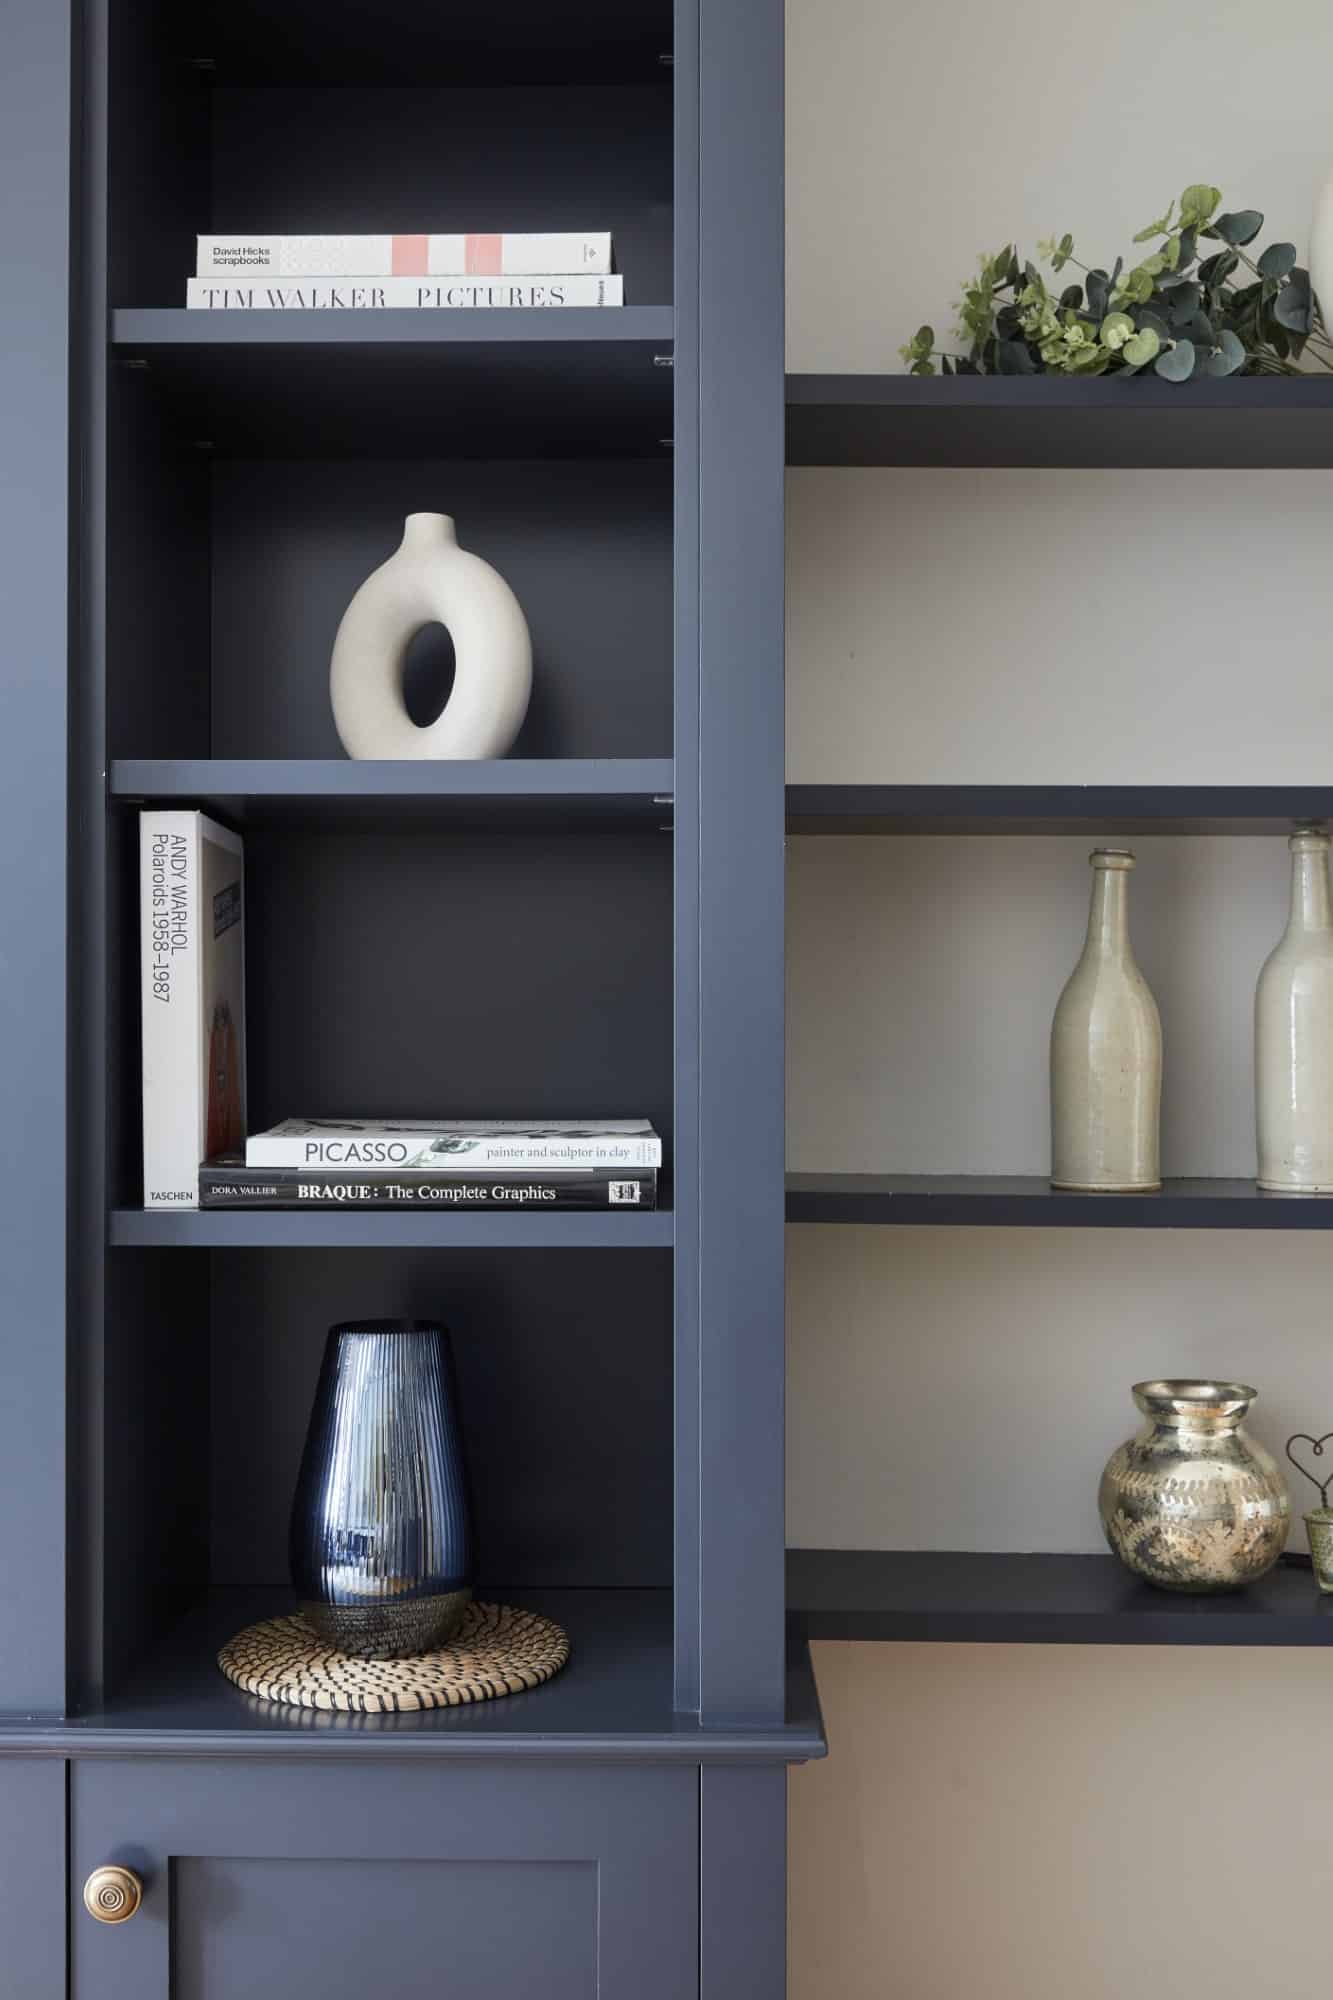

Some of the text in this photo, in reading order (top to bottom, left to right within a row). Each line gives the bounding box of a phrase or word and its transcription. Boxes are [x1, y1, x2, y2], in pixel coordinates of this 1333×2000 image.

[212, 247, 271, 256] David Hicks
[212, 256, 271, 267] scrapbooks
[200, 288, 566, 308] TIM WALKER PICTURES
[152, 834, 169, 907] Polaroids
[170, 834, 188, 956] ANDY WARHOL
[305, 1142, 408, 1162] PICASSO
[487, 1147, 525, 1160] painter
[527, 1146, 547, 1158] and
[549, 1146, 594, 1160] sculptor
[596, 1147, 606, 1158] in
[608, 1146, 630, 1160] clay
[150, 1191, 193, 1201] TASCHEN
[211, 1185, 238, 1195] DORA
[239, 1185, 278, 1195] VALLIER
[385, 1185, 415, 1199] The
[418, 1185, 488, 1202] Complete
[491, 1185, 557, 1202] Graphics
